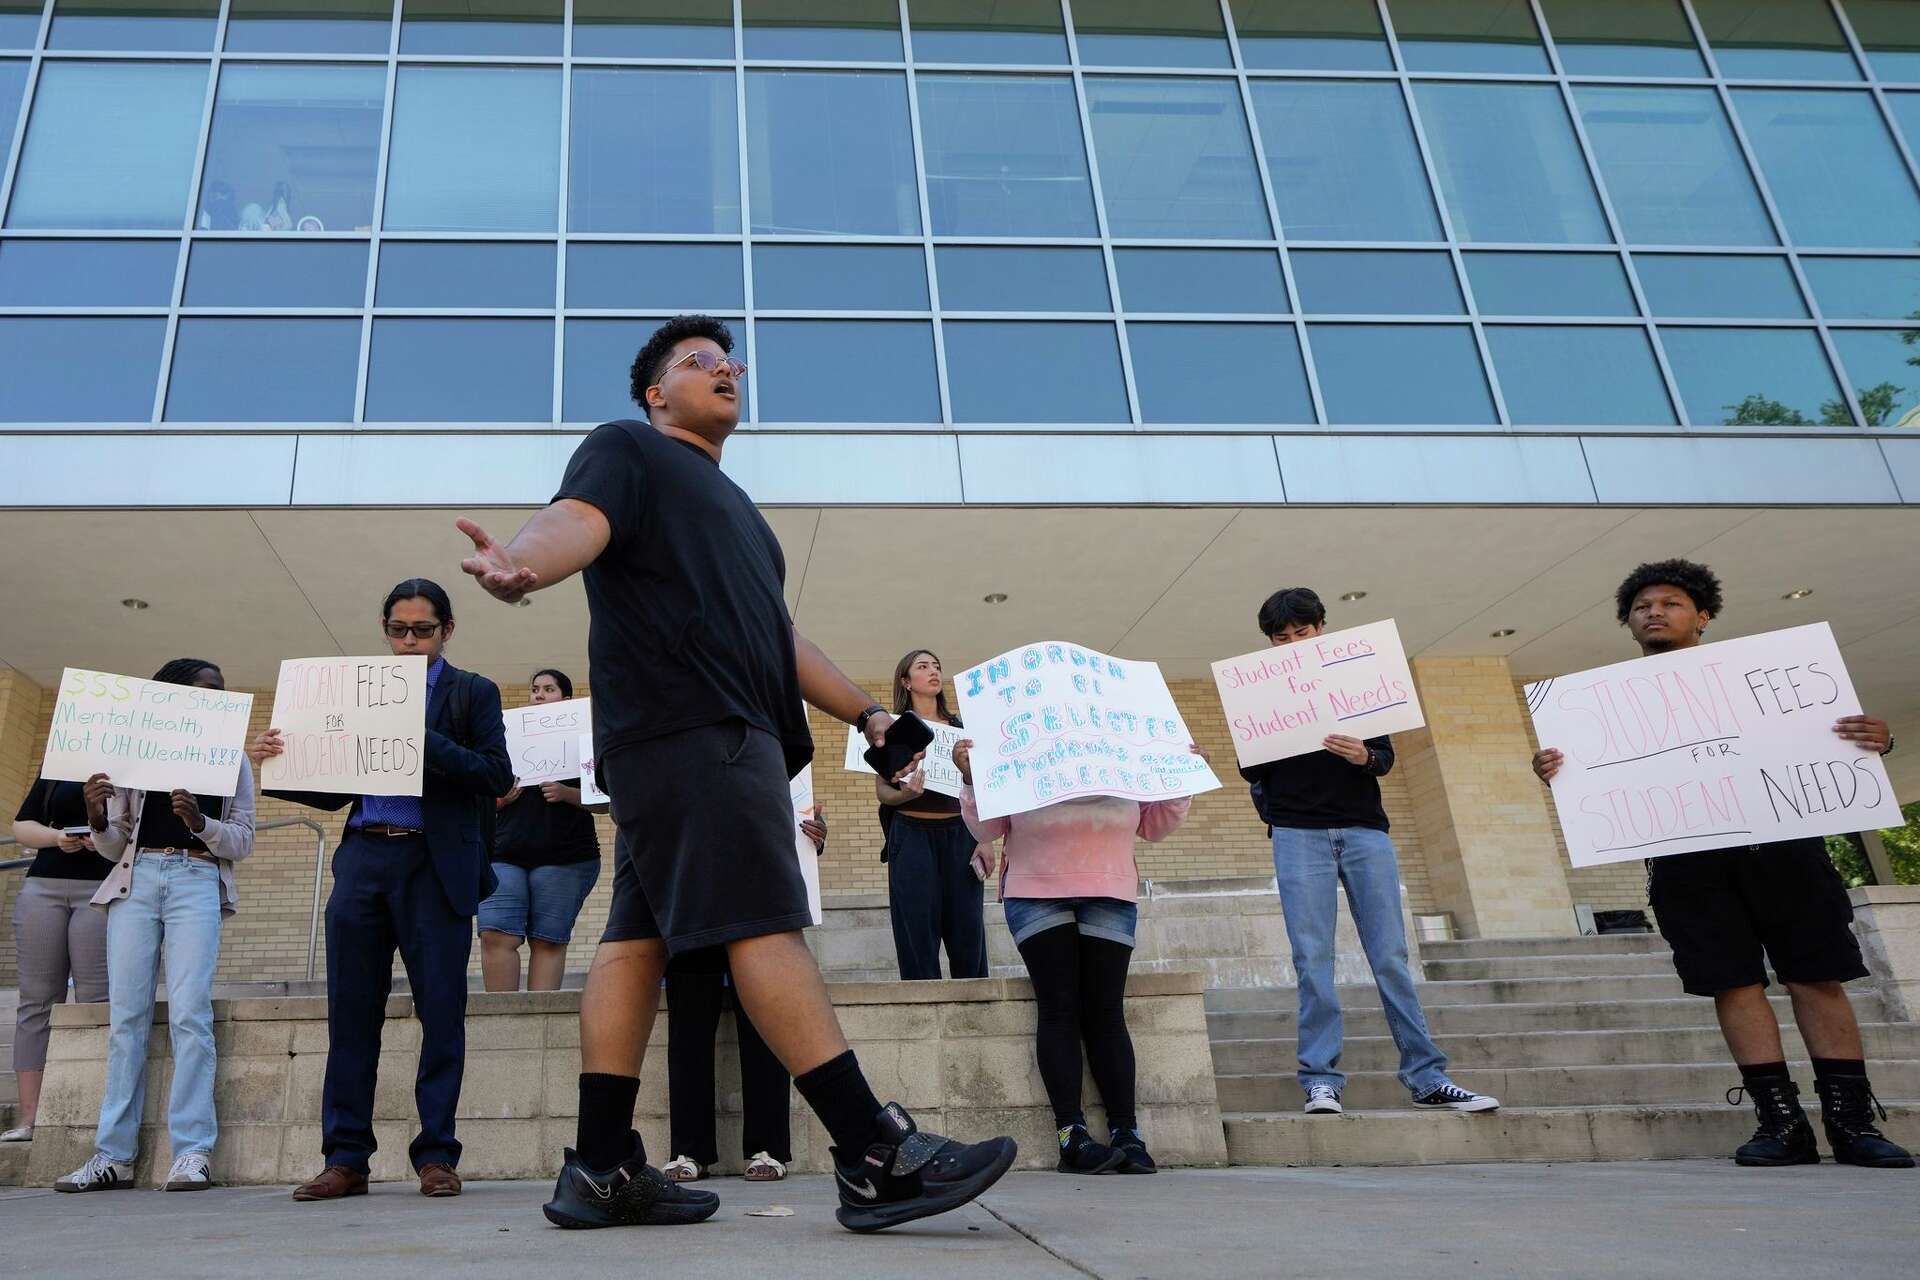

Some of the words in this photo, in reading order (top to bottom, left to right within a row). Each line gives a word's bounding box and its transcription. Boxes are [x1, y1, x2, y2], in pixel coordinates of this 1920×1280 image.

[1221, 650, 1304, 689] Student
[1315, 637, 1374, 662] Fees
[139, 683, 178, 704] For
[184, 690, 252, 717] Student
[277, 664, 349, 713] STUDENT
[356, 664, 409, 708] FEES
[1287, 675, 1322, 695] for
[55, 702, 135, 727] Mental
[325, 713, 345, 730] FOR
[522, 711, 578, 733] Fees
[1234, 699, 1320, 742] Student
[1328, 673, 1408, 716] Needs
[1558, 662, 1743, 765] STUDENT
[1745, 662, 1838, 715] FEES
[50, 729, 92, 752] Not
[101, 732, 132, 756] UH
[356, 735, 419, 777] NEEDS
[521, 740, 567, 775] Say!
[1691, 742, 1741, 764] FOR
[1580, 775, 1747, 848] STUDENT
[1760, 757, 1881, 822] NEEDS
